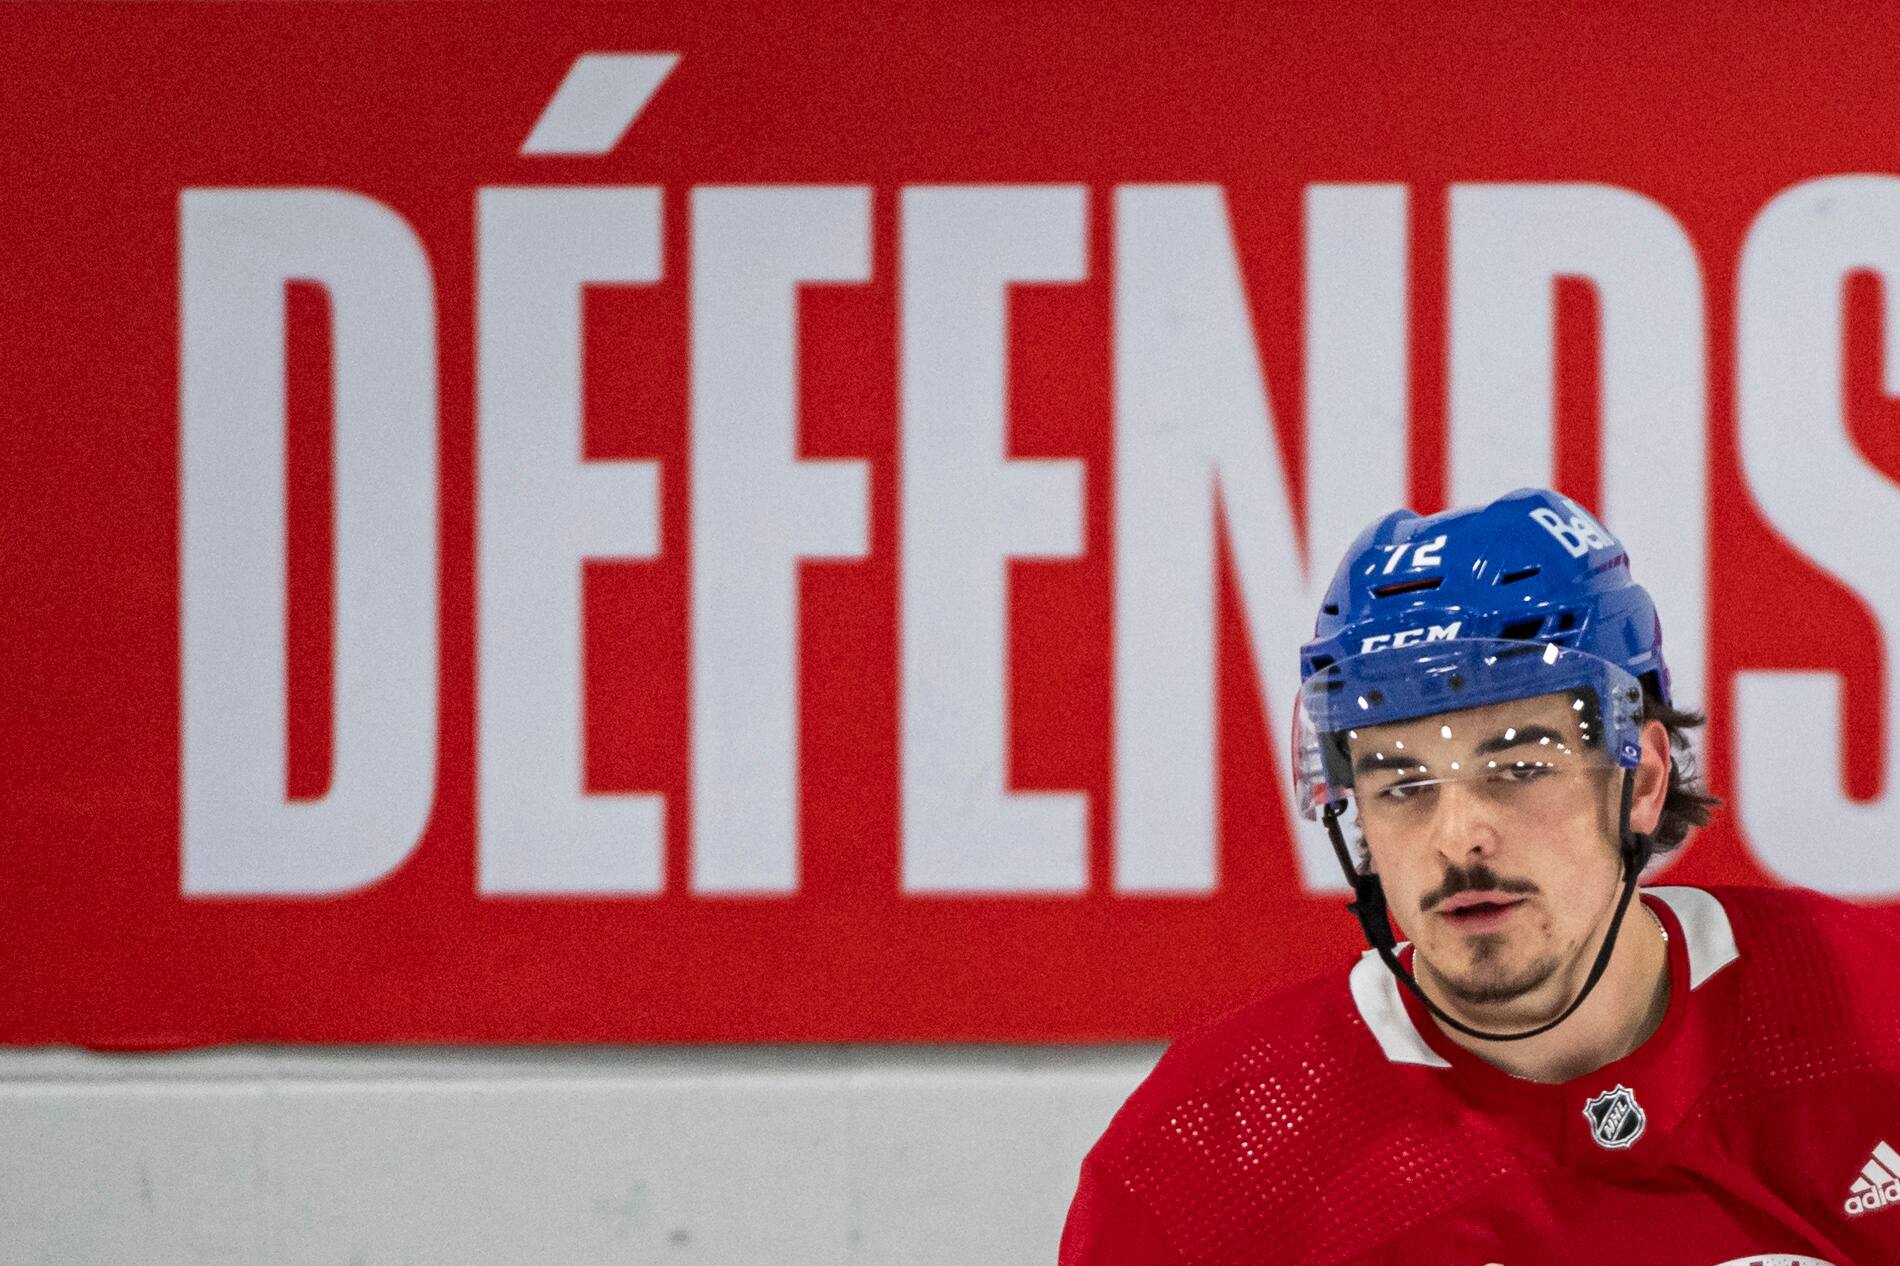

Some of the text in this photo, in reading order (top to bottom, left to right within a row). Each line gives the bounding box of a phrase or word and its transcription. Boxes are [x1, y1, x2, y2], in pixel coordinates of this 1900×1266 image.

[1382, 534, 1448, 575] 72
[1360, 621, 1462, 655] CCM
[1604, 1101, 1628, 1139] NHL
